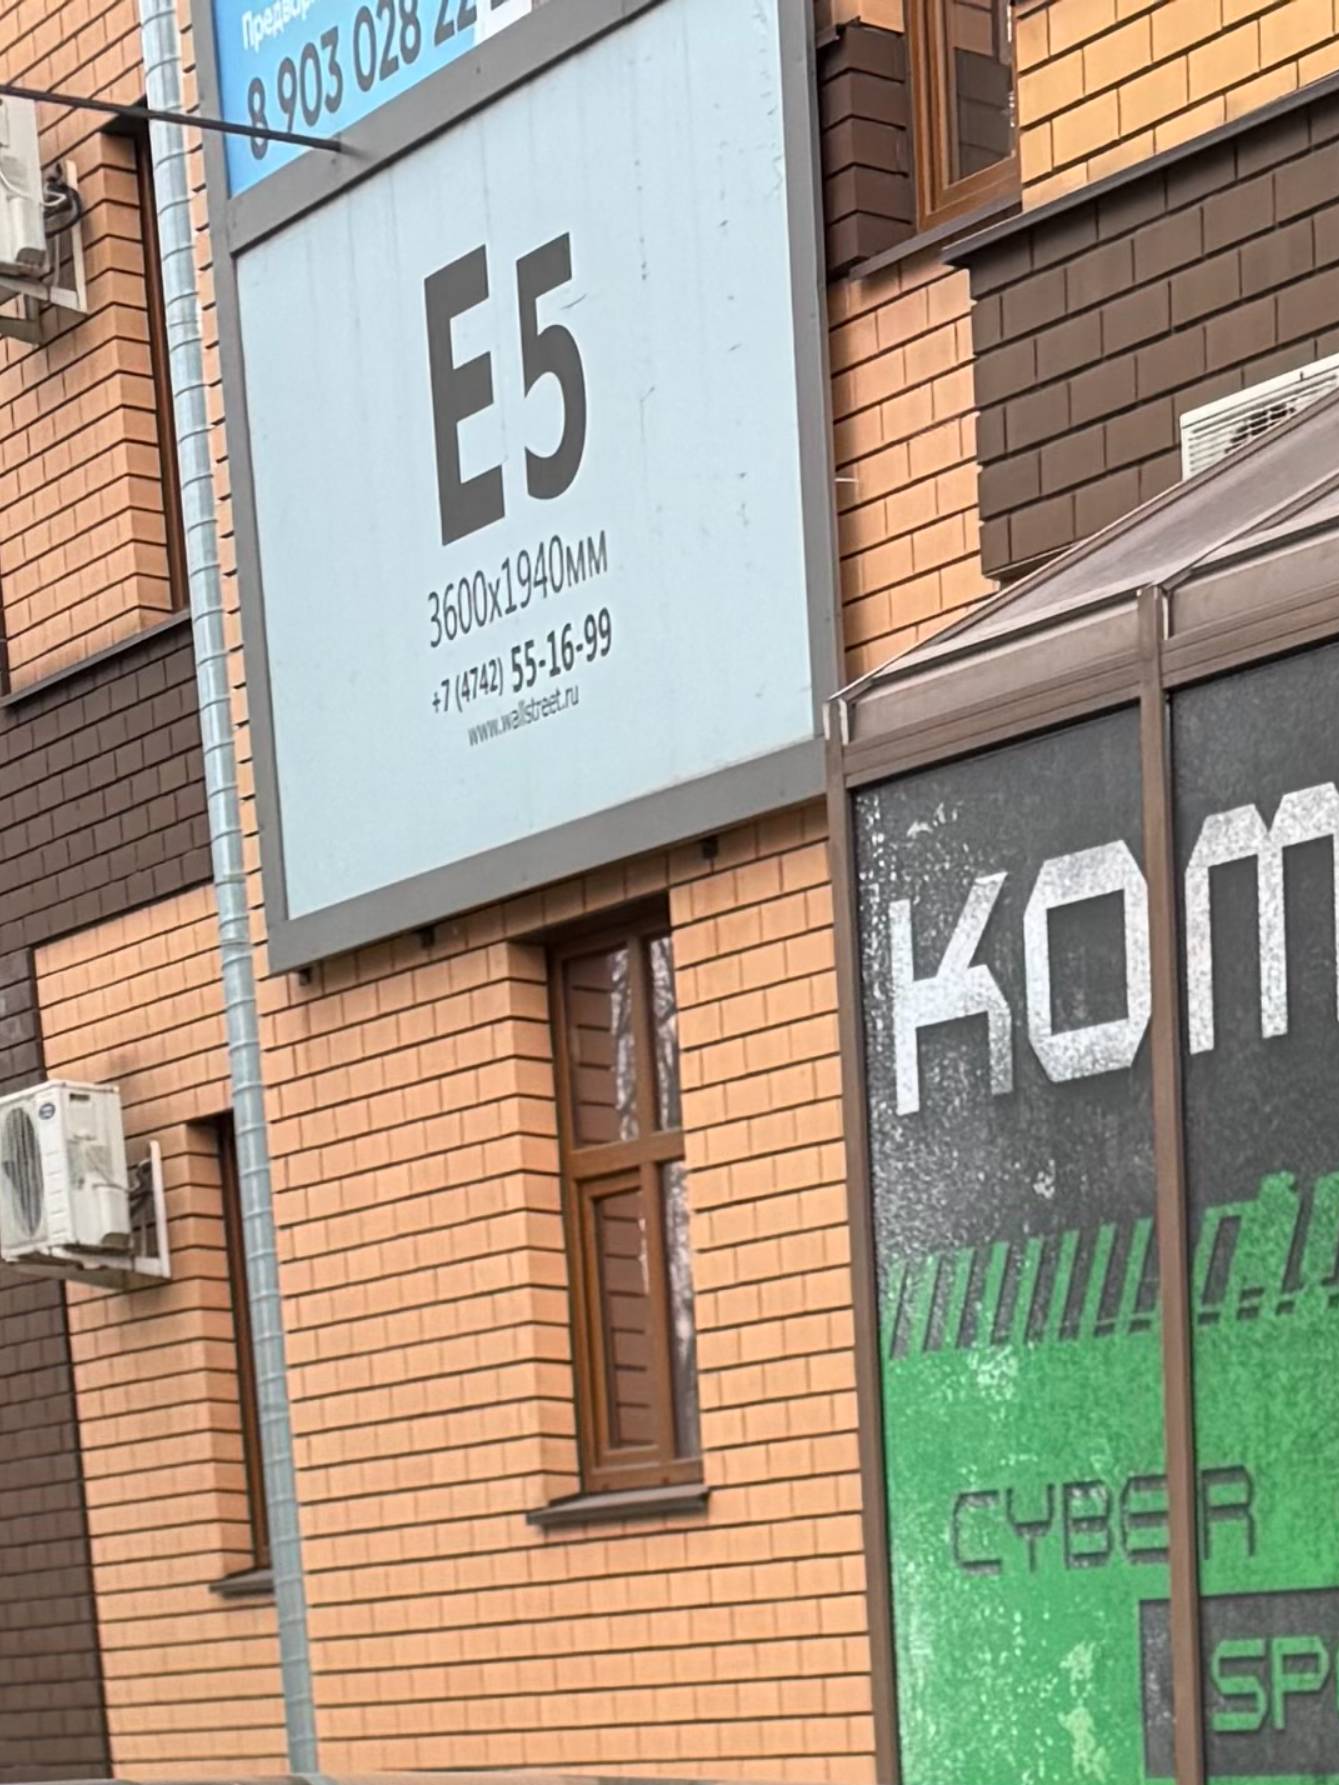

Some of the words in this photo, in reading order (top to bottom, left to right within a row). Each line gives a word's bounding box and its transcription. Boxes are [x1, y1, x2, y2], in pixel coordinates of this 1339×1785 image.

[248, 77, 269, 161] 8
[277, 25, 344, 134] 903
[353, 0, 422, 93] 028
[424, 233, 588, 546] E5
[432, 679, 450, 714] +7
[455, 657, 505, 713] (4742)
[511, 606, 613, 694] 55-16-99
[468, 684, 580, 747] www.wallstreet.ru
[952, 1464, 1257, 1577] CYBER
